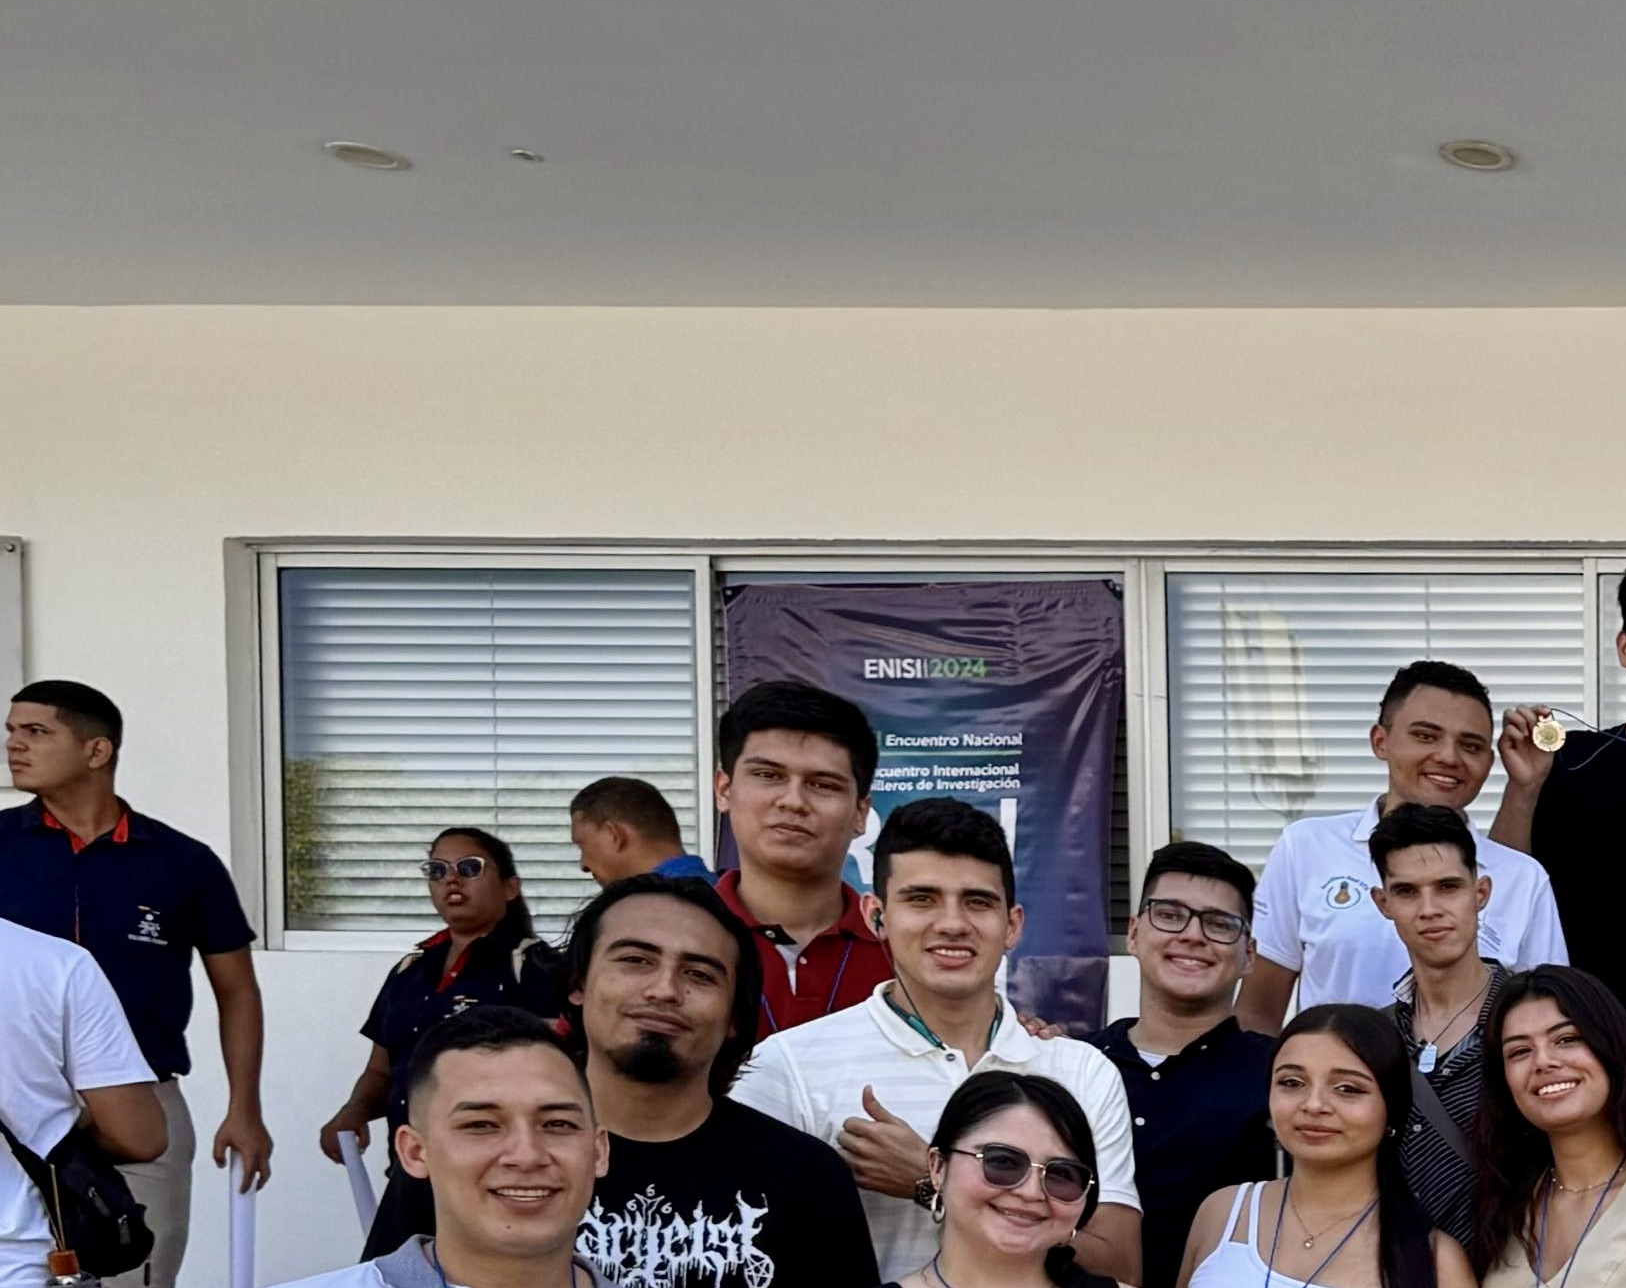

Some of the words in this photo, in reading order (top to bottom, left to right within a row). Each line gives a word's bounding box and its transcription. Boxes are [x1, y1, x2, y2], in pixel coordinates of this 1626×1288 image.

[864, 658, 924, 680] ENISI
[928, 657, 988, 679] 2024
[885, 734, 960, 747] Encuentro
[962, 732, 1024, 747] Nacional
[875, 764, 931, 778] cuentro
[932, 763, 1020, 777] Internacional
[915, 778, 934, 791] de
[936, 778, 1021, 793] Investigación
